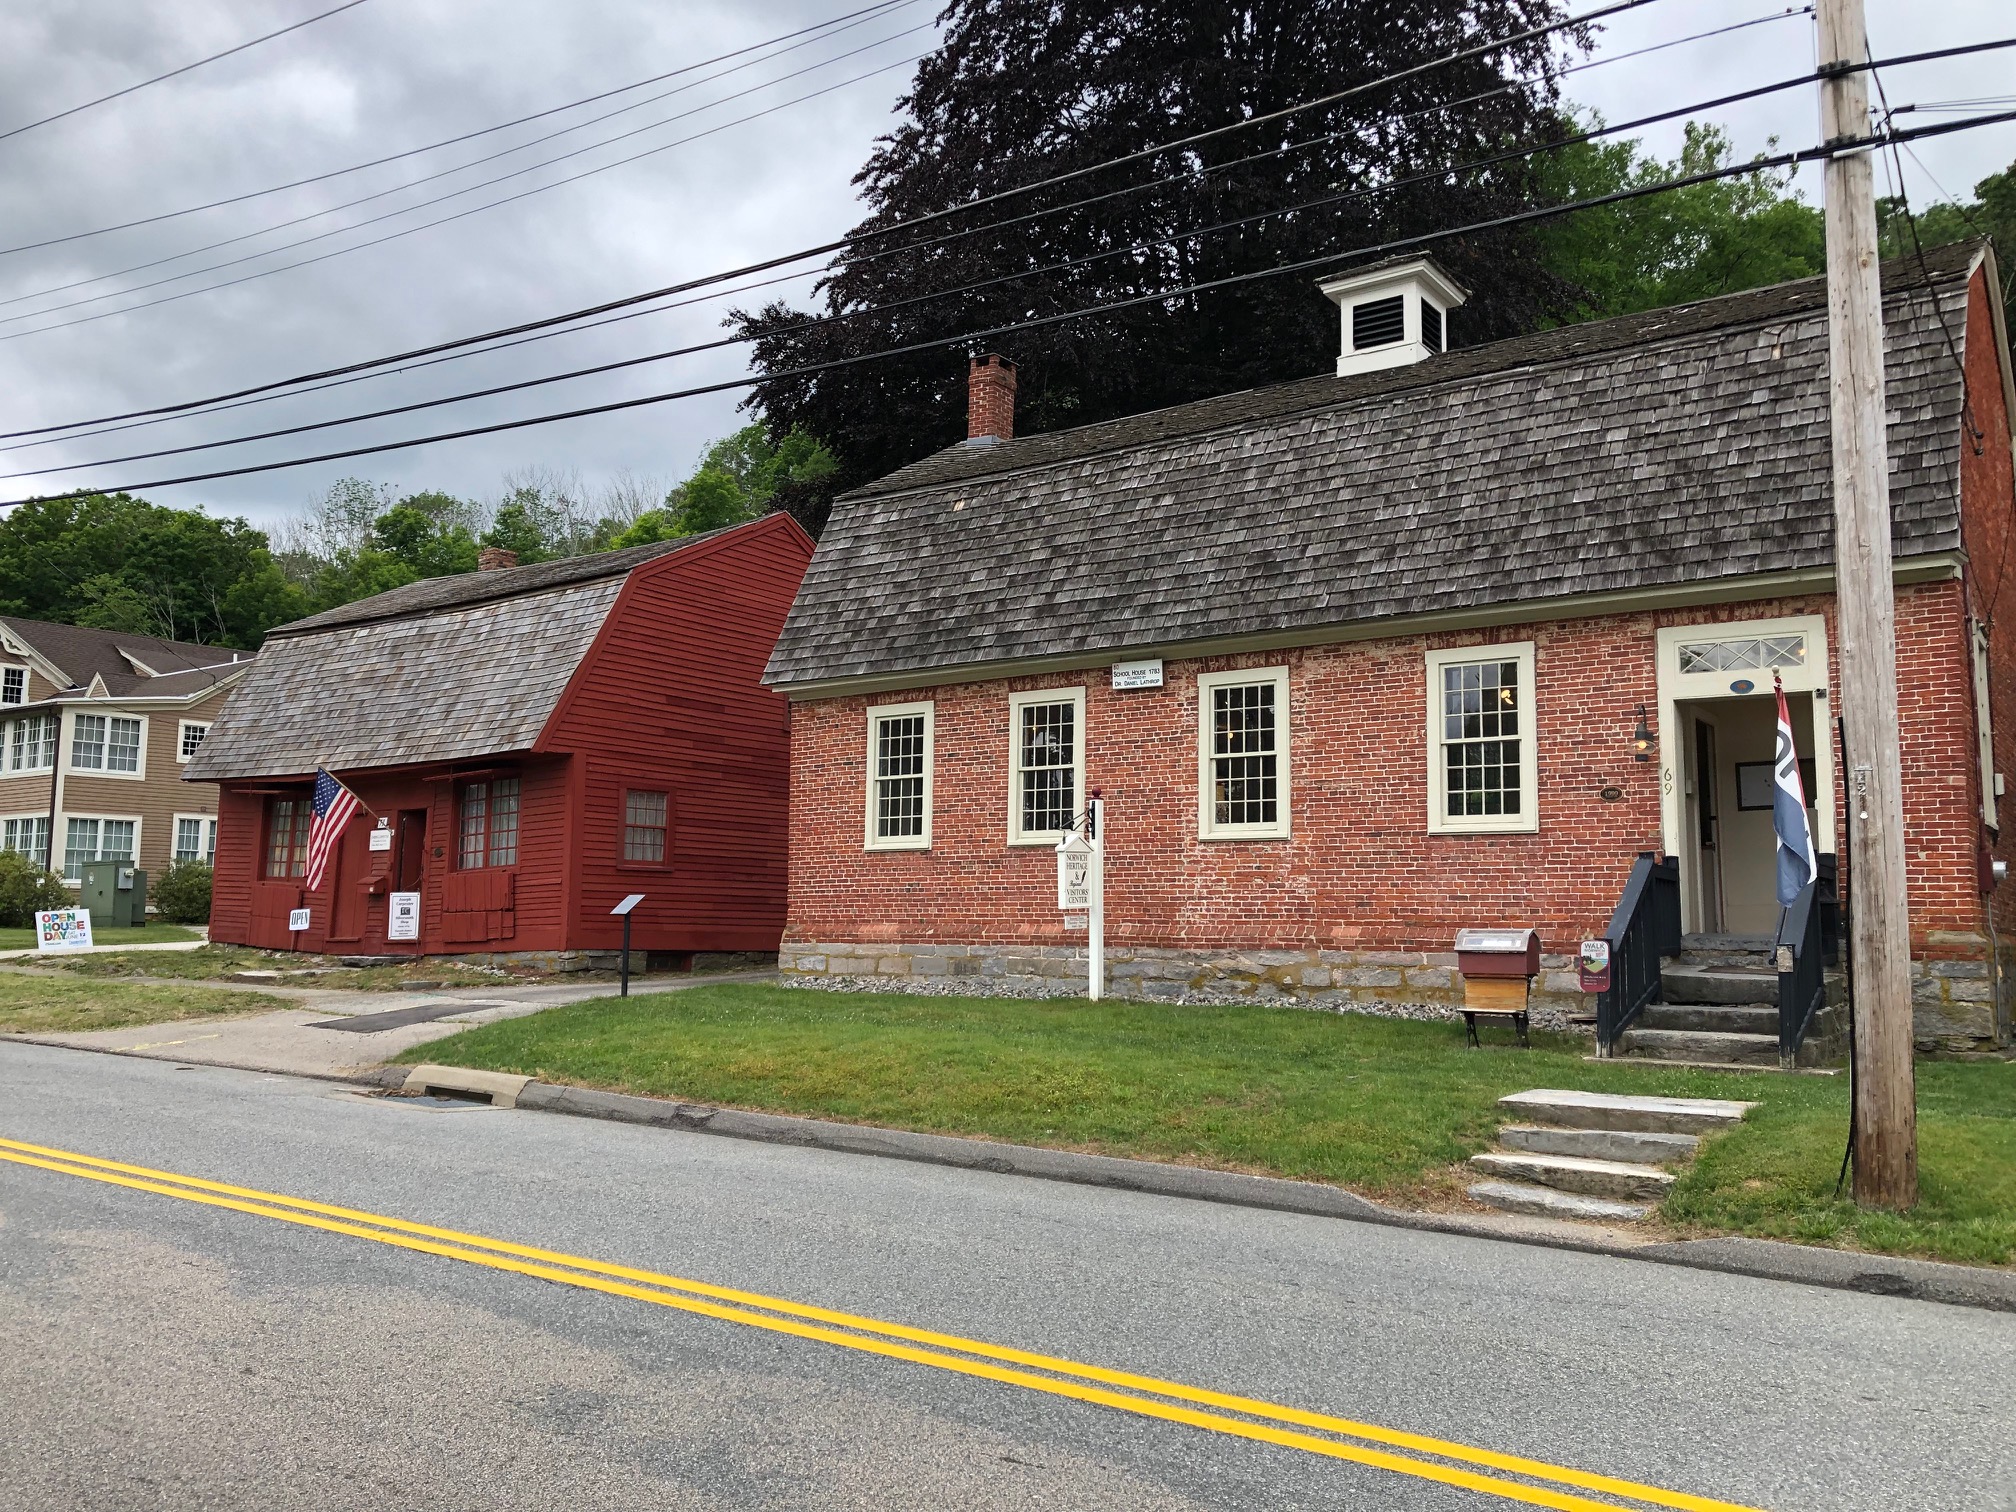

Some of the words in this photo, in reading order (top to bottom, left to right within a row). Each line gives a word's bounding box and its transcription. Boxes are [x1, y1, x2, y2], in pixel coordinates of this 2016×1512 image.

[1066, 862, 1088, 870] HERITAGE
[1074, 871, 1080, 880] &
[42, 913, 75, 923] OPEN
[291, 912, 308, 925] OPEN
[43, 921, 85, 932] HOUSE
[44, 931, 67, 941] DAY
